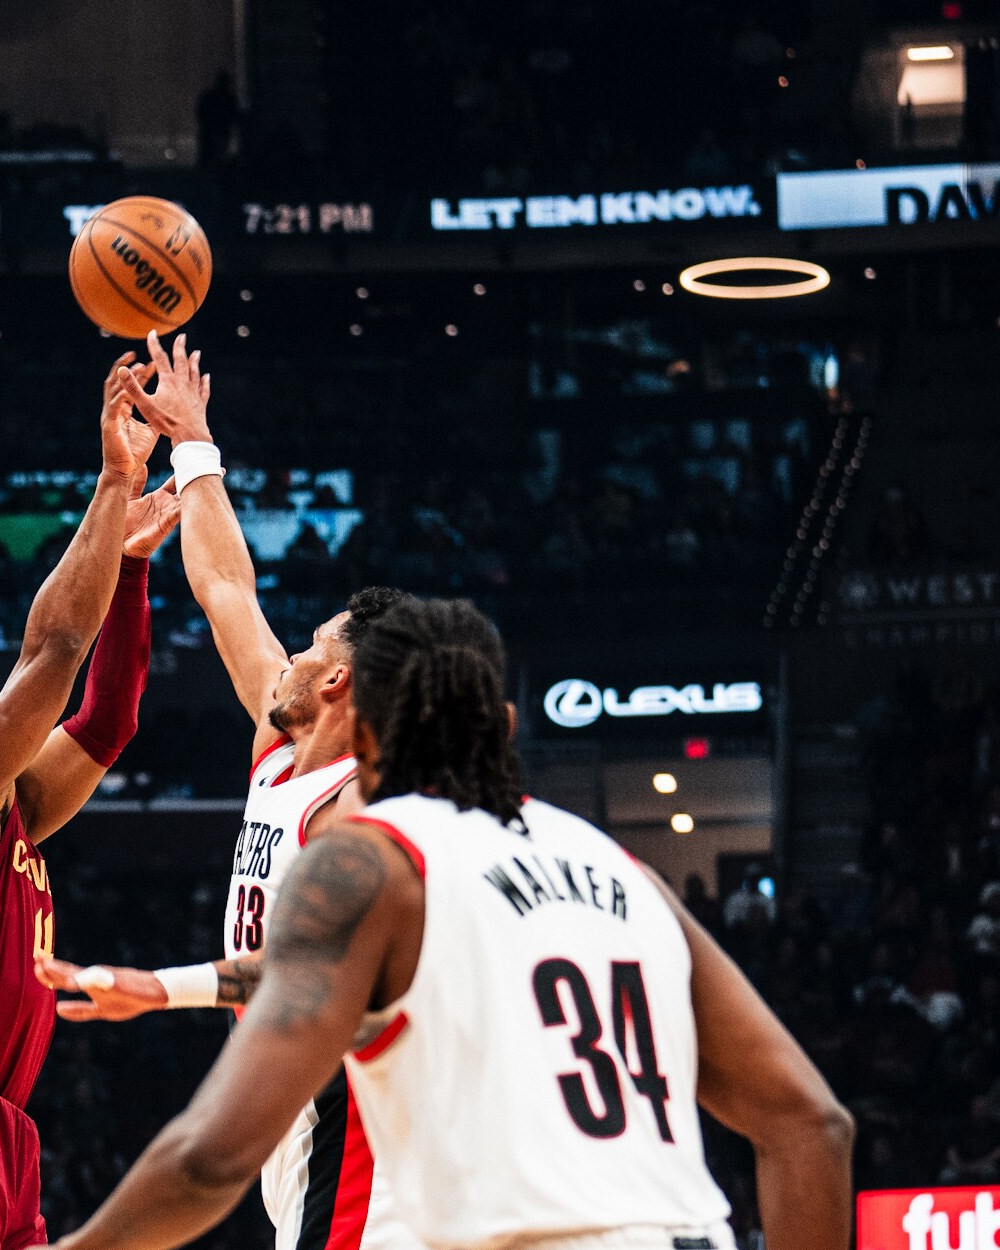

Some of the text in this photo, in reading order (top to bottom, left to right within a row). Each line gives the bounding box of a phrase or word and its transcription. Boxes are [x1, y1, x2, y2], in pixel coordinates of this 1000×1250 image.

[243, 203, 373, 234] 7:21 PM
[431, 186, 761, 229] LET EM KNOW.
[604, 682, 763, 717] LEXUS
[483, 853, 629, 922] WALKER
[233, 884, 266, 953] 33
[532, 957, 677, 1145] 34
